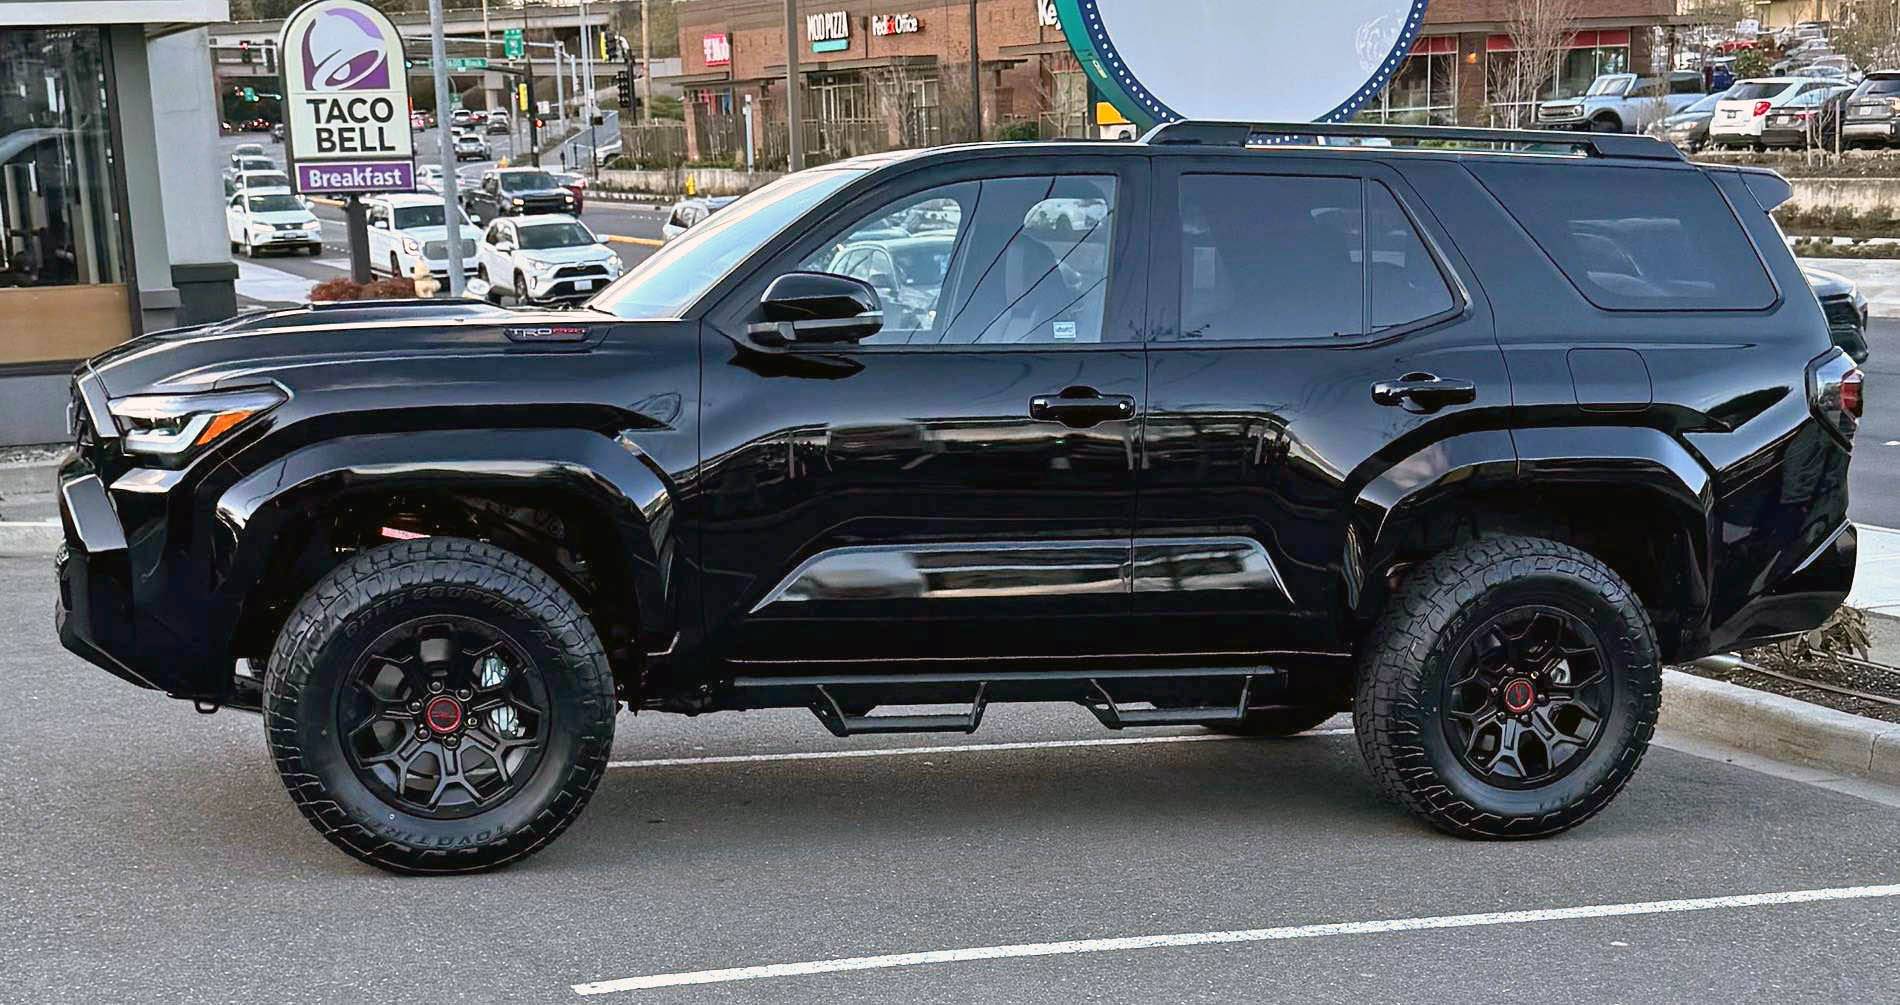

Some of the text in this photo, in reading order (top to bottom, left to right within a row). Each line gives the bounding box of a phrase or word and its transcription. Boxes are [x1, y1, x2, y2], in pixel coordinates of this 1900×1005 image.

[825, 10, 849, 39] PIZZA
[895, 14, 918, 34] Office
[306, 97, 394, 124] TACO
[315, 127, 396, 153] BELL
[308, 167, 402, 188] Breakfast
